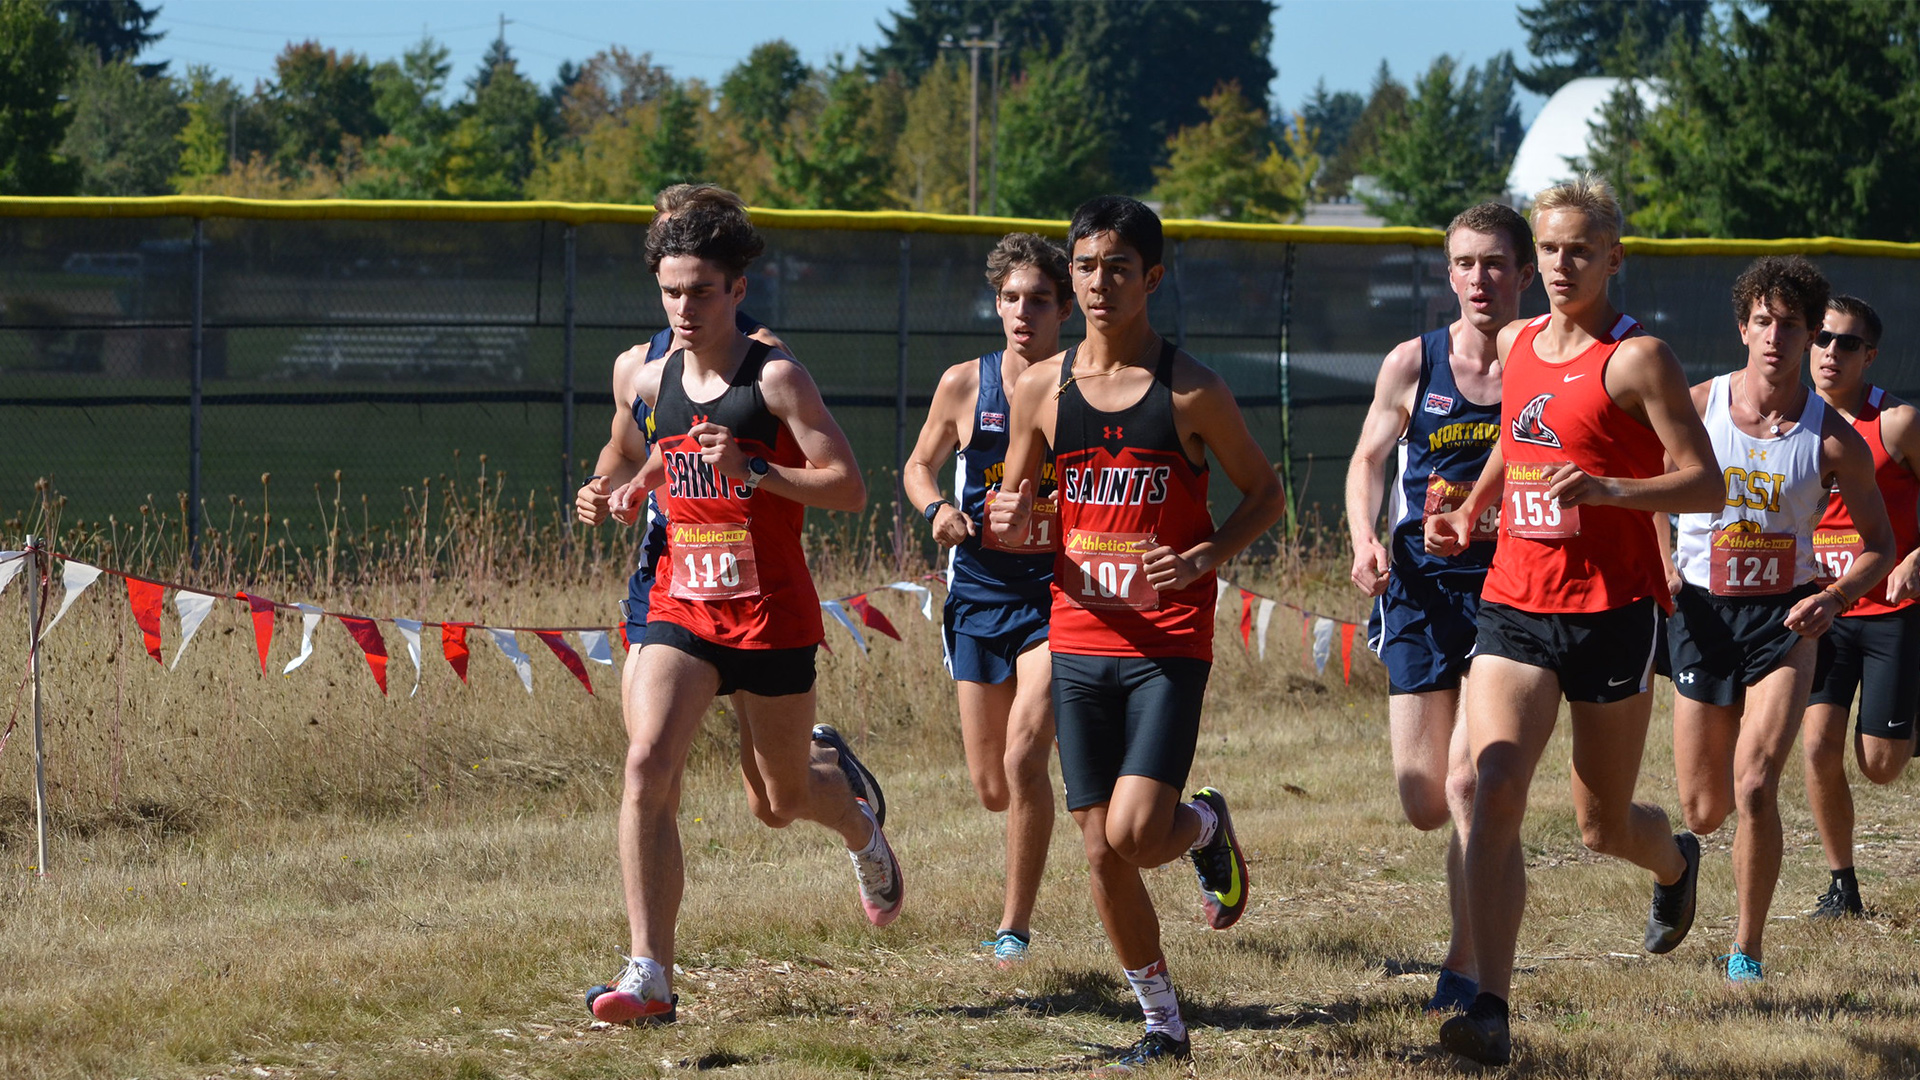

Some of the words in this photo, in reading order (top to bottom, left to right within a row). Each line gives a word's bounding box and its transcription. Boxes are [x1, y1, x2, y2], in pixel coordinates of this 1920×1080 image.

[1428, 422, 1501, 452] NORTHW
[1065, 465, 1170, 506] SAINTS
[1506, 465, 1545, 481] Athleti
[1430, 479, 1470, 498] Athle
[1723, 466, 1785, 513] CSI
[1511, 491, 1561, 526] 153
[1813, 533, 1842, 545] thletic
[684, 552, 740, 588] 110
[1726, 557, 1780, 587] 124
[1815, 550, 1854, 578] 152
[1080, 561, 1138, 598] 107
